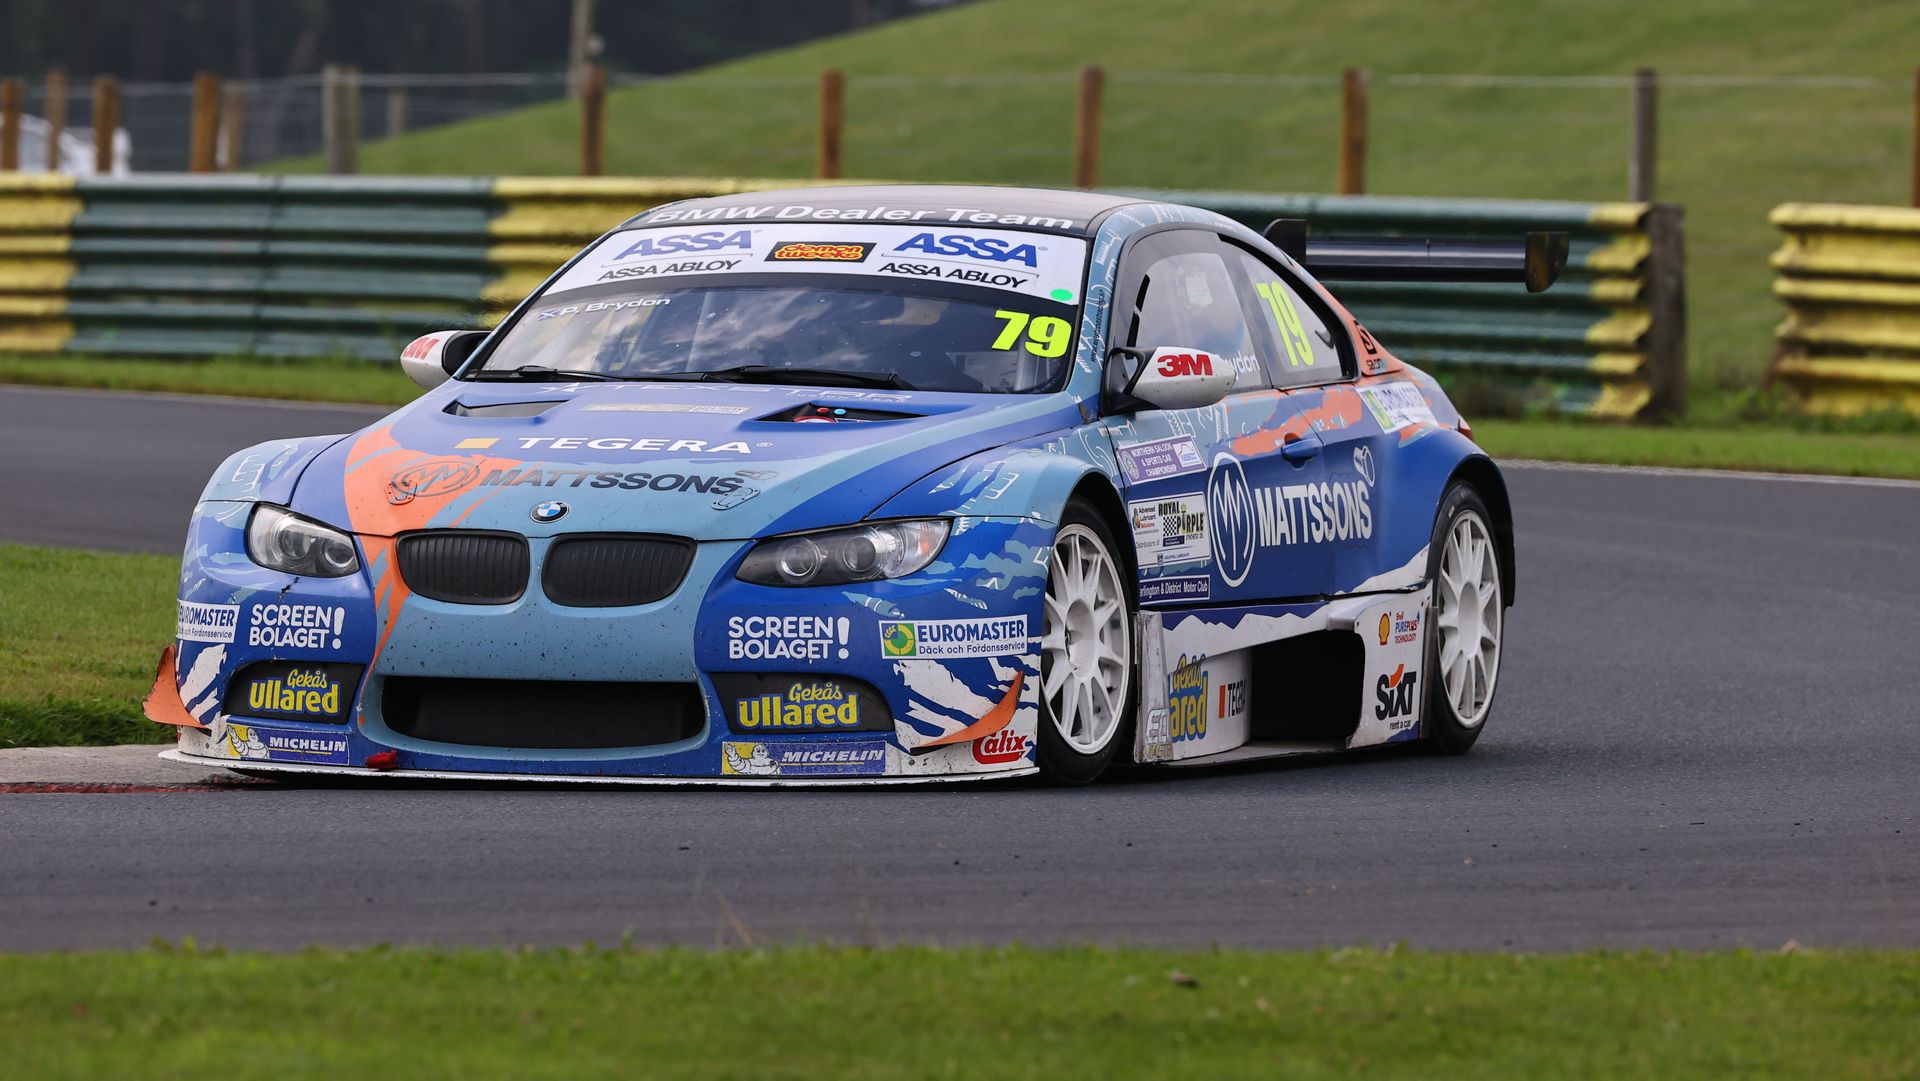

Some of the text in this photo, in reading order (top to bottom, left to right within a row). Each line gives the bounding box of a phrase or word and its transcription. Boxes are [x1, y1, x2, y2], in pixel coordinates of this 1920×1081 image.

[646, 205, 1074, 229] BMW Dealer Team
[612, 230, 751, 261] ASSA
[774, 250, 863, 260] tweeks
[781, 243, 864, 253] demon
[893, 233, 1038, 268] ASSA
[597, 259, 742, 281] ASSA ABLOY
[878, 262, 1029, 288] ASSA ABLOY
[560, 298, 671, 316] P. Brydon
[991, 309, 1072, 358] 79
[1255, 281, 1314, 366] 79
[1158, 354, 1213, 377] 3M
[1130, 444, 1155, 458] NORTHERN
[1145, 455, 1163, 467] SPORTS
[1162, 453, 1173, 464] CAR
[1145, 464, 1178, 477] CHAMPIONSHIP
[478, 470, 745, 495] MATTSSONS
[1158, 501, 1180, 516] ROYAL
[1254, 480, 1373, 547] MATTSSONS
[1161, 582, 1165, 595] &
[1165, 581, 1181, 595] District
[1183, 581, 1197, 593] Motor
[1197, 580, 1208, 592] Club
[250, 604, 333, 628] SCREEN
[728, 616, 833, 638] SCREEN
[249, 626, 330, 648] BOLAGET
[917, 620, 1025, 643] EUROMASTER
[729, 639, 834, 660] BOLAGET
[919, 641, 1025, 655] Däck och Fordonsservice
[288, 669, 328, 689] Gekås
[250, 679, 339, 713] Ullared
[789, 682, 842, 702] Gekås
[739, 695, 859, 727] Ullared
[1170, 677, 1207, 740] ared
[1390, 721, 1400, 731] rent
[1404, 719, 1412, 729] car
[269, 737, 346, 752] MICHELIN
[972, 729, 1028, 765] Calix
[782, 749, 884, 763] MICHELIN
